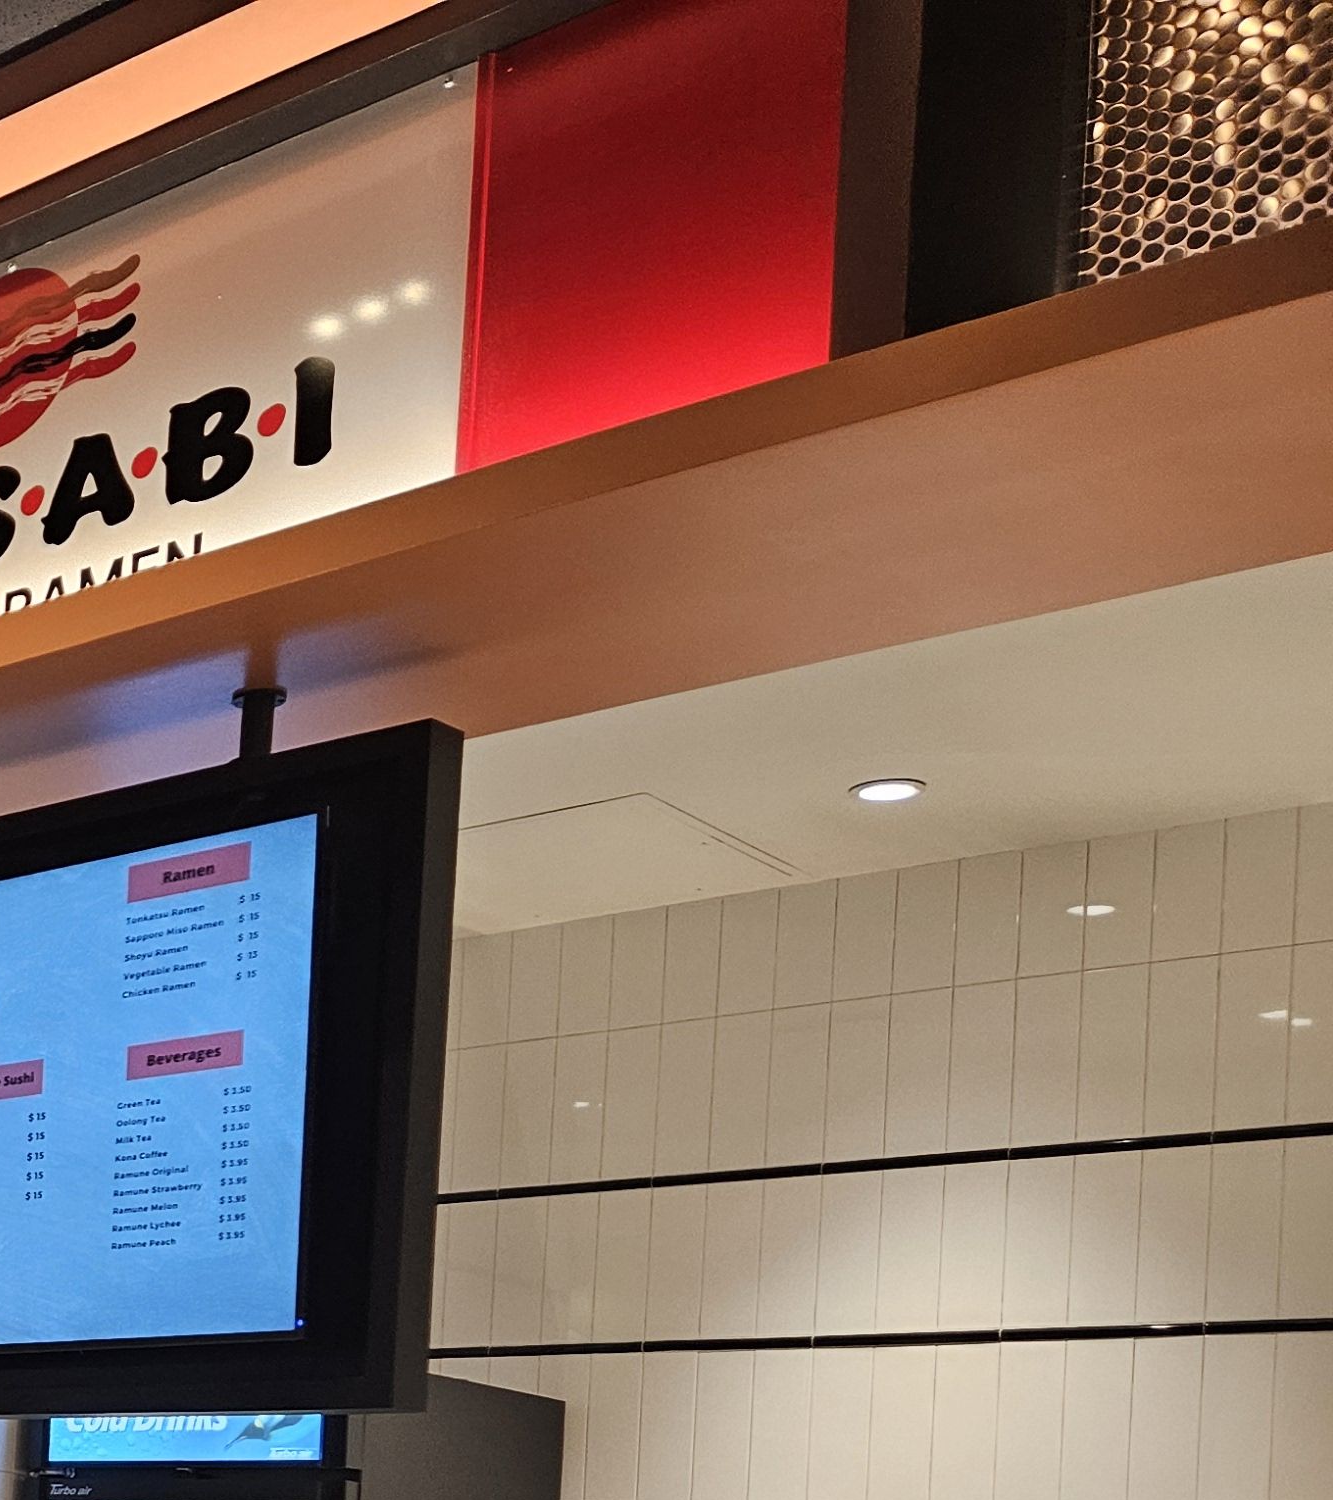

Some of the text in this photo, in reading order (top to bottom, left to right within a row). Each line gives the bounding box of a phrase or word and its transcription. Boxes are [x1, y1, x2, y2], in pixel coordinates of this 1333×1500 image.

[162, 864, 215, 884] Ramen
[171, 905, 205, 917] Ramen
[125, 920, 225, 944] Sapporo Miso Ramen
[124, 945, 189, 963] Shoyu Ramen
[123, 960, 207, 981] Vegetable Ramen
[122, 981, 196, 999] Chicken Ramen
[146, 1047, 222, 1066] Beverages
[3, 1072, 34, 1087] Sushi
[117, 1101, 143, 1110] Green
[116, 1117, 148, 1128] Oolong
[115, 1134, 152, 1145] Milk Tea
[115, 1151, 168, 1162] Kona Coffee
[114, 1165, 189, 1180] Ramune Original
[113, 1182, 203, 1197] Ramune Strawberry
[112, 1202, 179, 1215] Ramune Melon
[112, 1220, 181, 1232] Ramune Lychee
[111, 1237, 176, 1250] Ramune Peach
[49, 1483, 92, 1495] Turbo air
